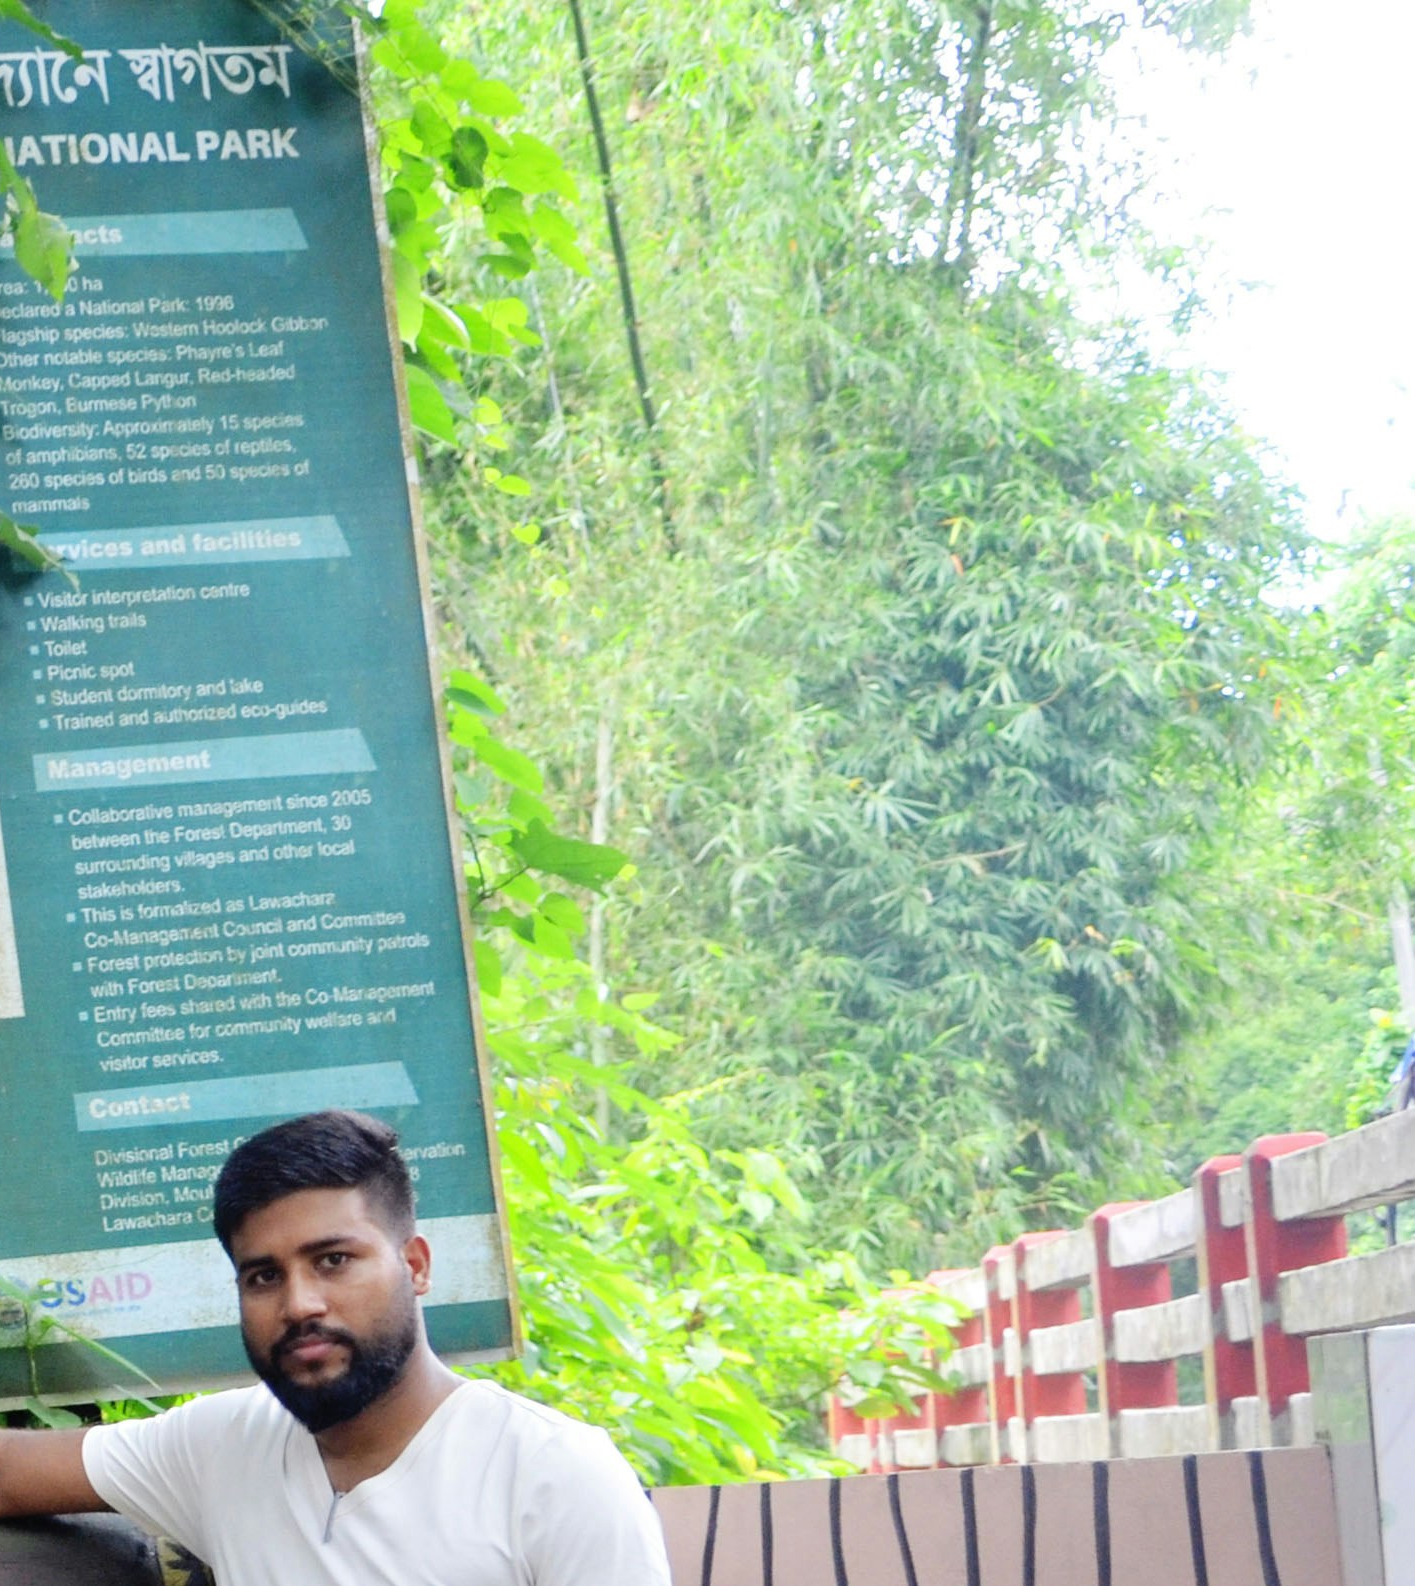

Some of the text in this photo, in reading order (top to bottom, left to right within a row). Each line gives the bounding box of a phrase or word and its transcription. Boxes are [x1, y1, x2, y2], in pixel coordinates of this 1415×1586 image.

[118, 41, 292, 101] স্বাগতম
[196, 127, 300, 160] PARK
[82, 276, 103, 291] ha
[65, 304, 76, 317] a
[79, 299, 145, 316] National
[195, 295, 235, 312] 1996
[68, 371, 131, 391] Capped
[197, 364, 295, 384] Red-headed
[192, 530, 301, 552] facilities
[91, 585, 196, 607] interpretation
[199, 582, 250, 599] centre
[40, 612, 147, 634] Walking trails
[43, 640, 88, 657] Toilet
[47, 661, 135, 681] Picnic spot
[51, 677, 264, 707] Student dormitory and lake
[47, 752, 211, 778] Management
[68, 788, 372, 826] Collaborative management since 2005
[71, 833, 141, 851] between
[143, 829, 171, 845] the
[173, 824, 226, 843] Forest
[331, 814, 352, 831] 30
[74, 839, 356, 875] surrounding villages and other local
[90, 981, 124, 998] with
[127, 976, 181, 995] Forest
[89, 1093, 191, 1119] Contact
[95, 1145, 173, 1166] Divisional
[177, 1143, 230, 1161] Forest
